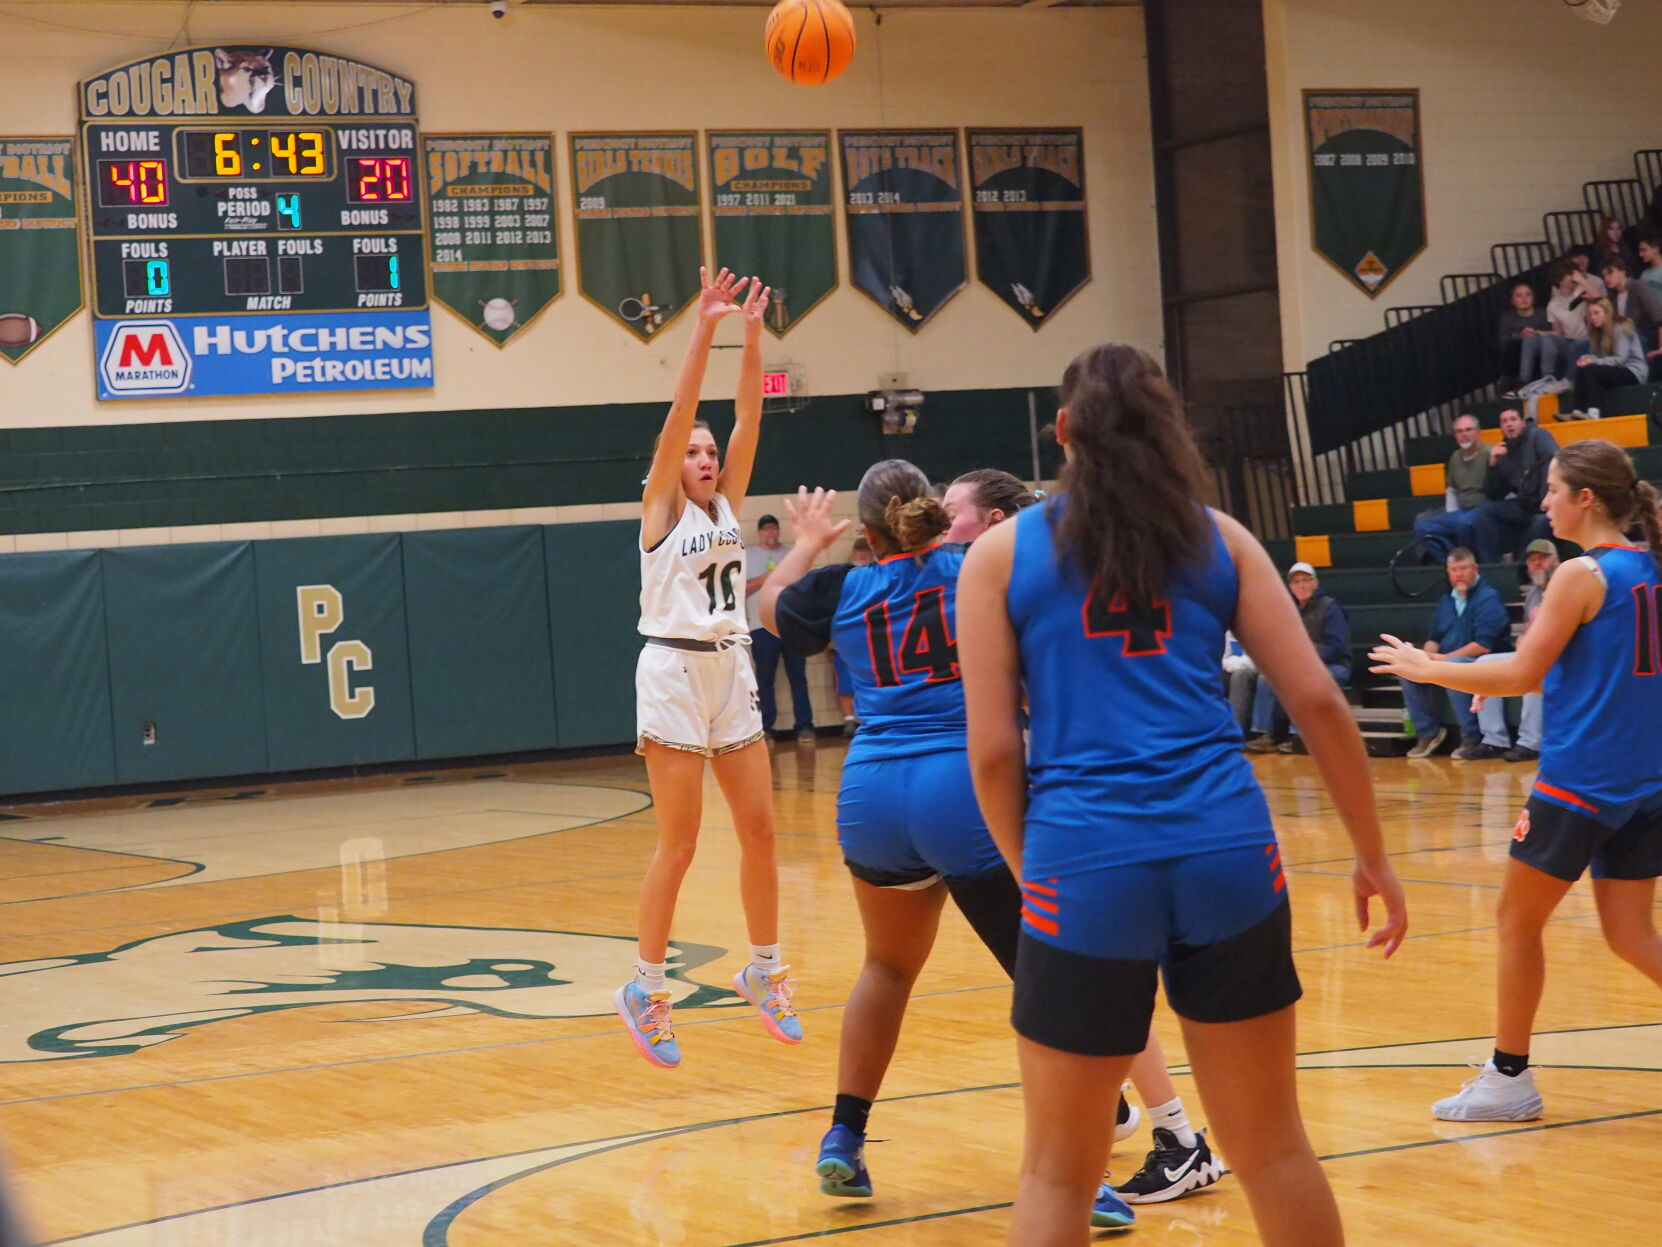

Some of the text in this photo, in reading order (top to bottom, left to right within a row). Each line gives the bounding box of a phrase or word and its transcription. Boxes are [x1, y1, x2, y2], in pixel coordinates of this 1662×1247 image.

[87, 51, 412, 116] COUGAR COUNTRY
[100, 131, 160, 151] HOME
[338, 130, 413, 150] VISITOR
[214, 132, 325, 176] 6:43
[429, 151, 552, 195] SOFTBALL
[715, 147, 826, 186] GOLF
[111, 161, 166, 204] 40
[358, 158, 409, 200] 20
[228, 187, 258, 199] POSS
[217, 201, 270, 216] PERIOD
[277, 194, 300, 228] 4
[340, 210, 389, 226] BONUS
[127, 213, 178, 229] BONUS
[121, 242, 169, 258] FOULS
[213, 239, 324, 256] PLAYER FOULS
[353, 238, 398, 254] FOULS
[436, 248, 463, 263] 2014
[146, 260, 169, 295] 0
[389, 256, 399, 289] 1
[125, 299, 172, 313] POINTS
[246, 296, 292, 310] MATCH
[357, 293, 403, 307] POINTS
[115, 369, 180, 381] MARATHON
[764, 373, 788, 394] EXIT
[682, 531, 714, 557] LADY
[863, 585, 960, 689] 14
